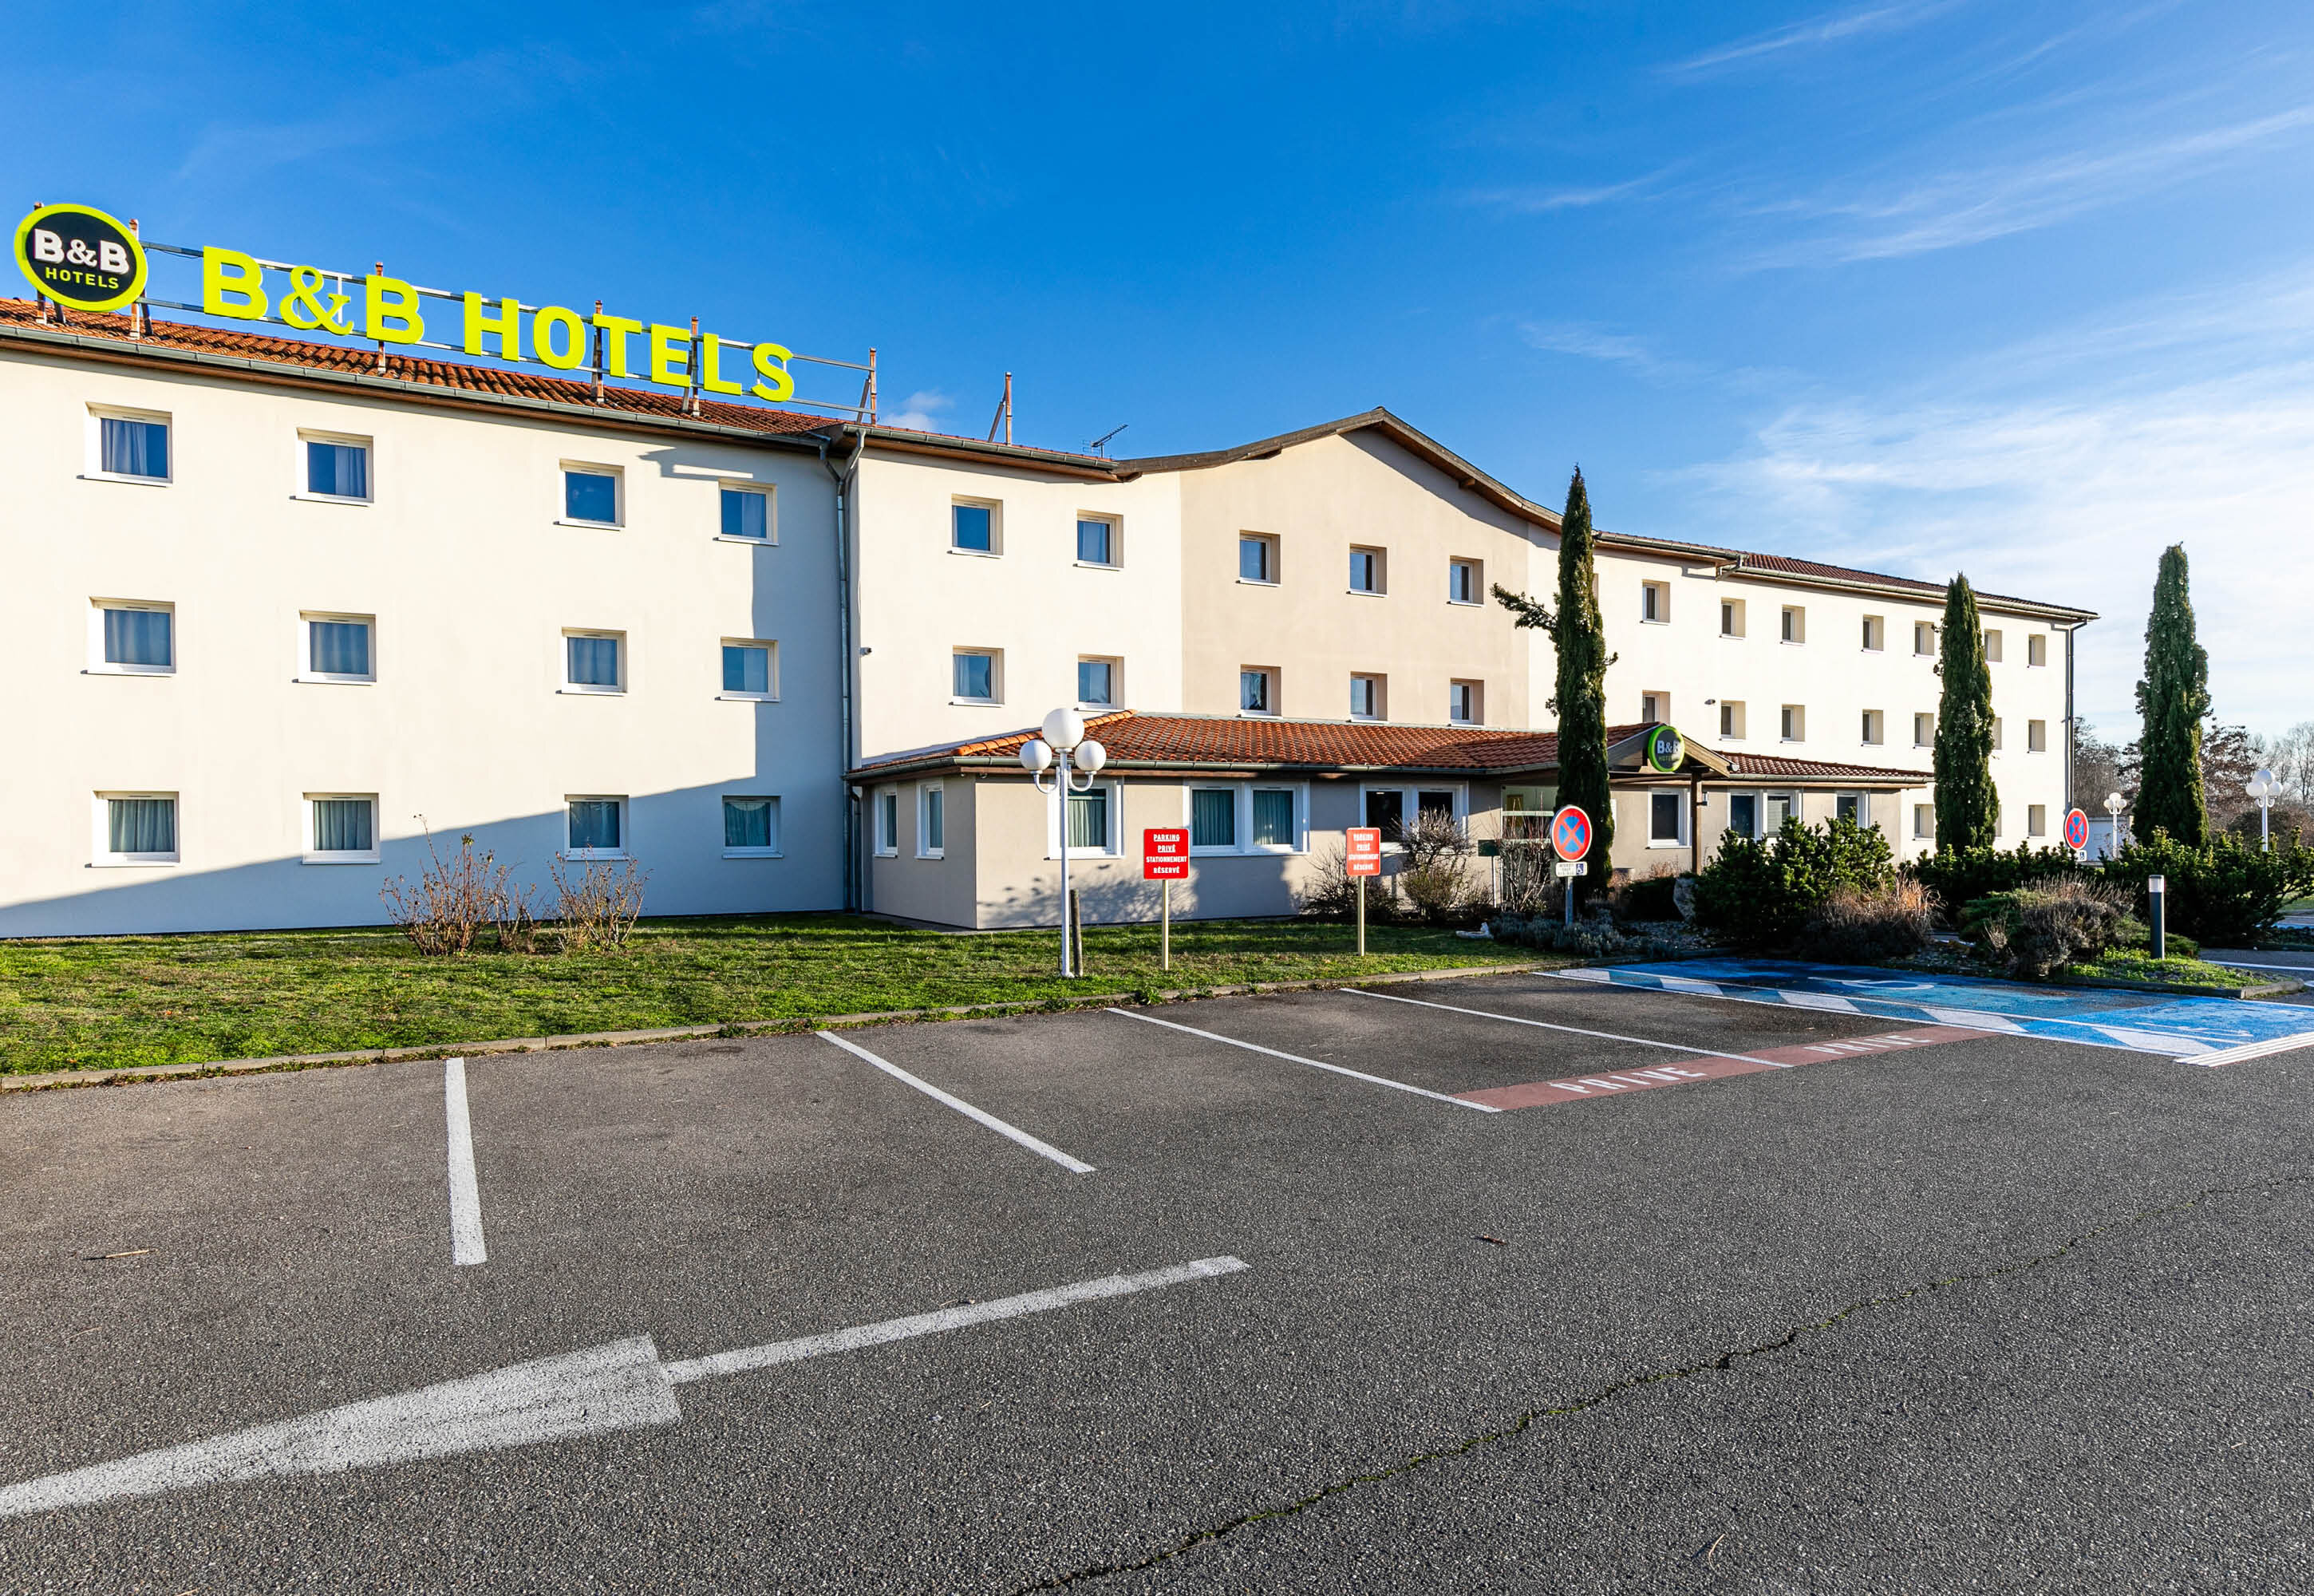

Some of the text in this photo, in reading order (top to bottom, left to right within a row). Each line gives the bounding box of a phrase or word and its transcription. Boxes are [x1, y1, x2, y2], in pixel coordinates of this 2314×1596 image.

[34, 228, 130, 275] B&B
[45, 267, 119, 290] HOTELS
[202, 245, 796, 403] B&B HOTELS
[1657, 740, 1680, 754] B&B
[1153, 833, 1180, 842] PARKING
[1157, 843, 1176, 853] PRIVÉ
[1547, 1067, 1708, 1094] PRIVE
